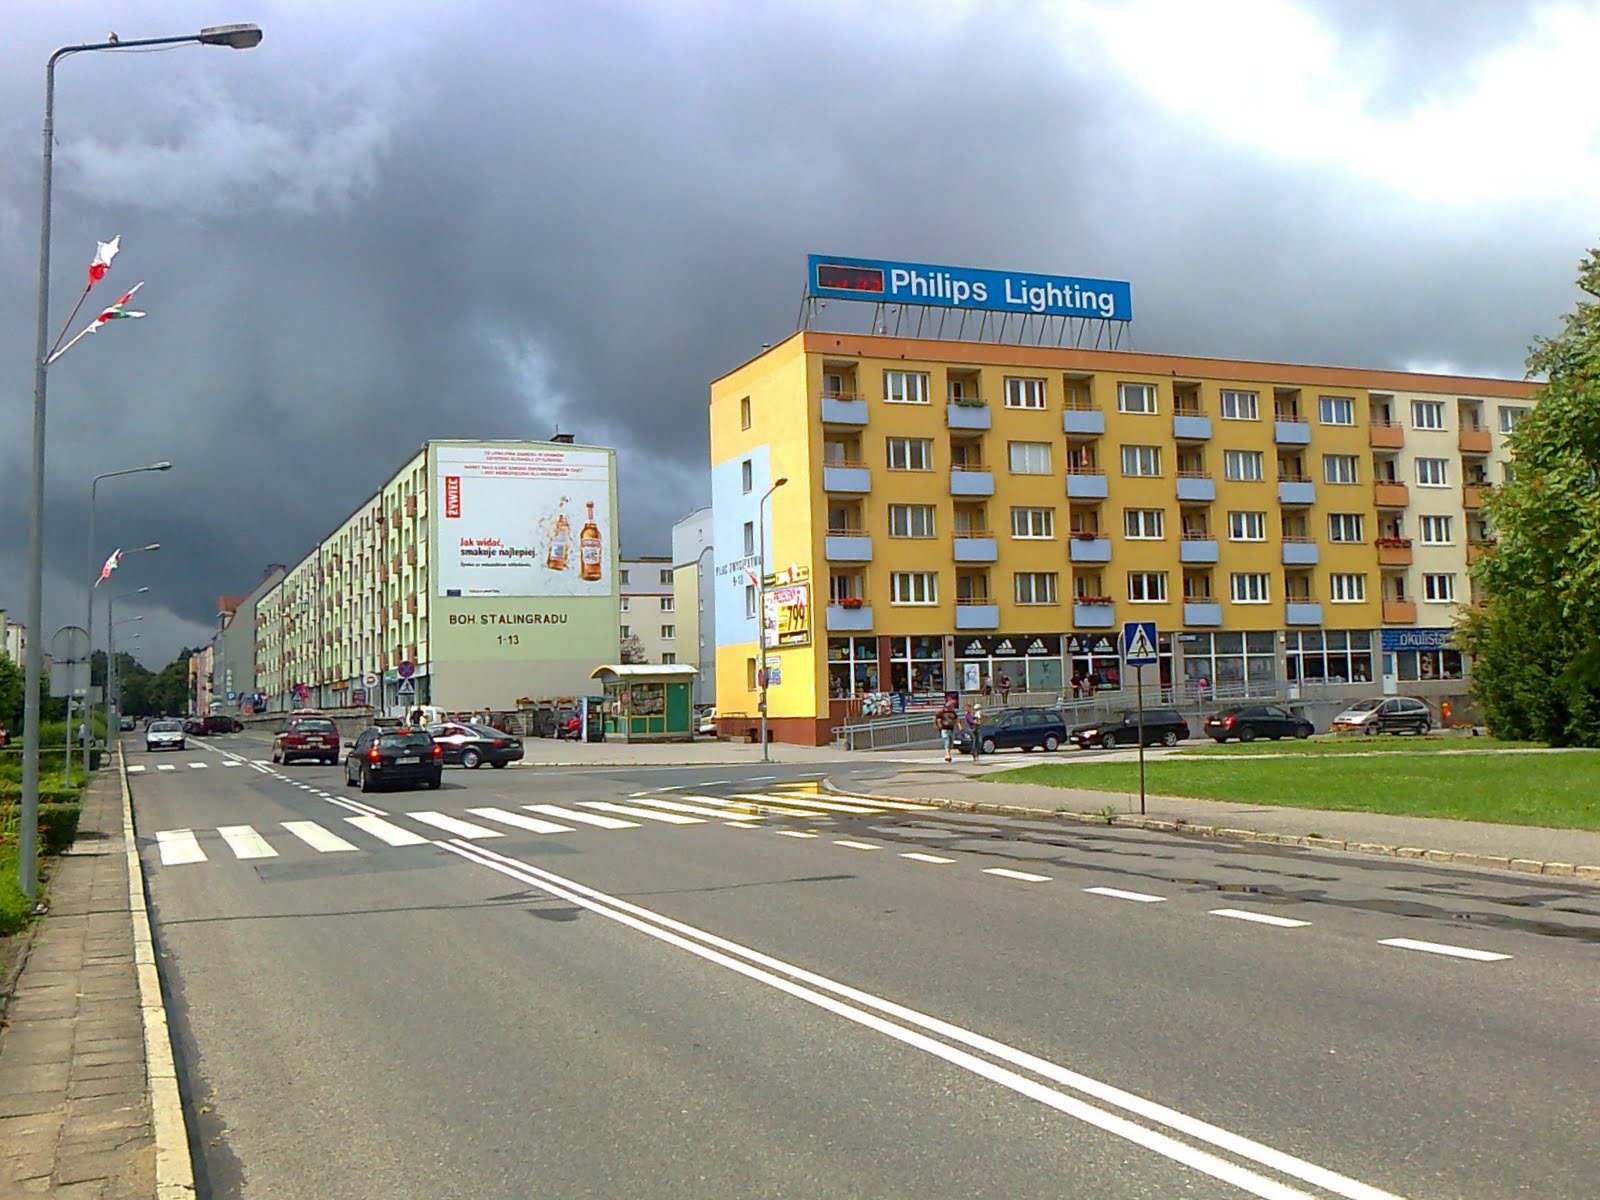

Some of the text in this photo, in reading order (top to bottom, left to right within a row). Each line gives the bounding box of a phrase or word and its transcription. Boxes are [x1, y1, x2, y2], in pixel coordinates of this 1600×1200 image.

[891, 268, 1115, 317] Philips Lighting
[460, 537, 475, 547] Jak
[460, 547, 497, 559] smakuje
[480, 614, 568, 625] STALINGRADU
[497, 634, 520, 645] 1-13
